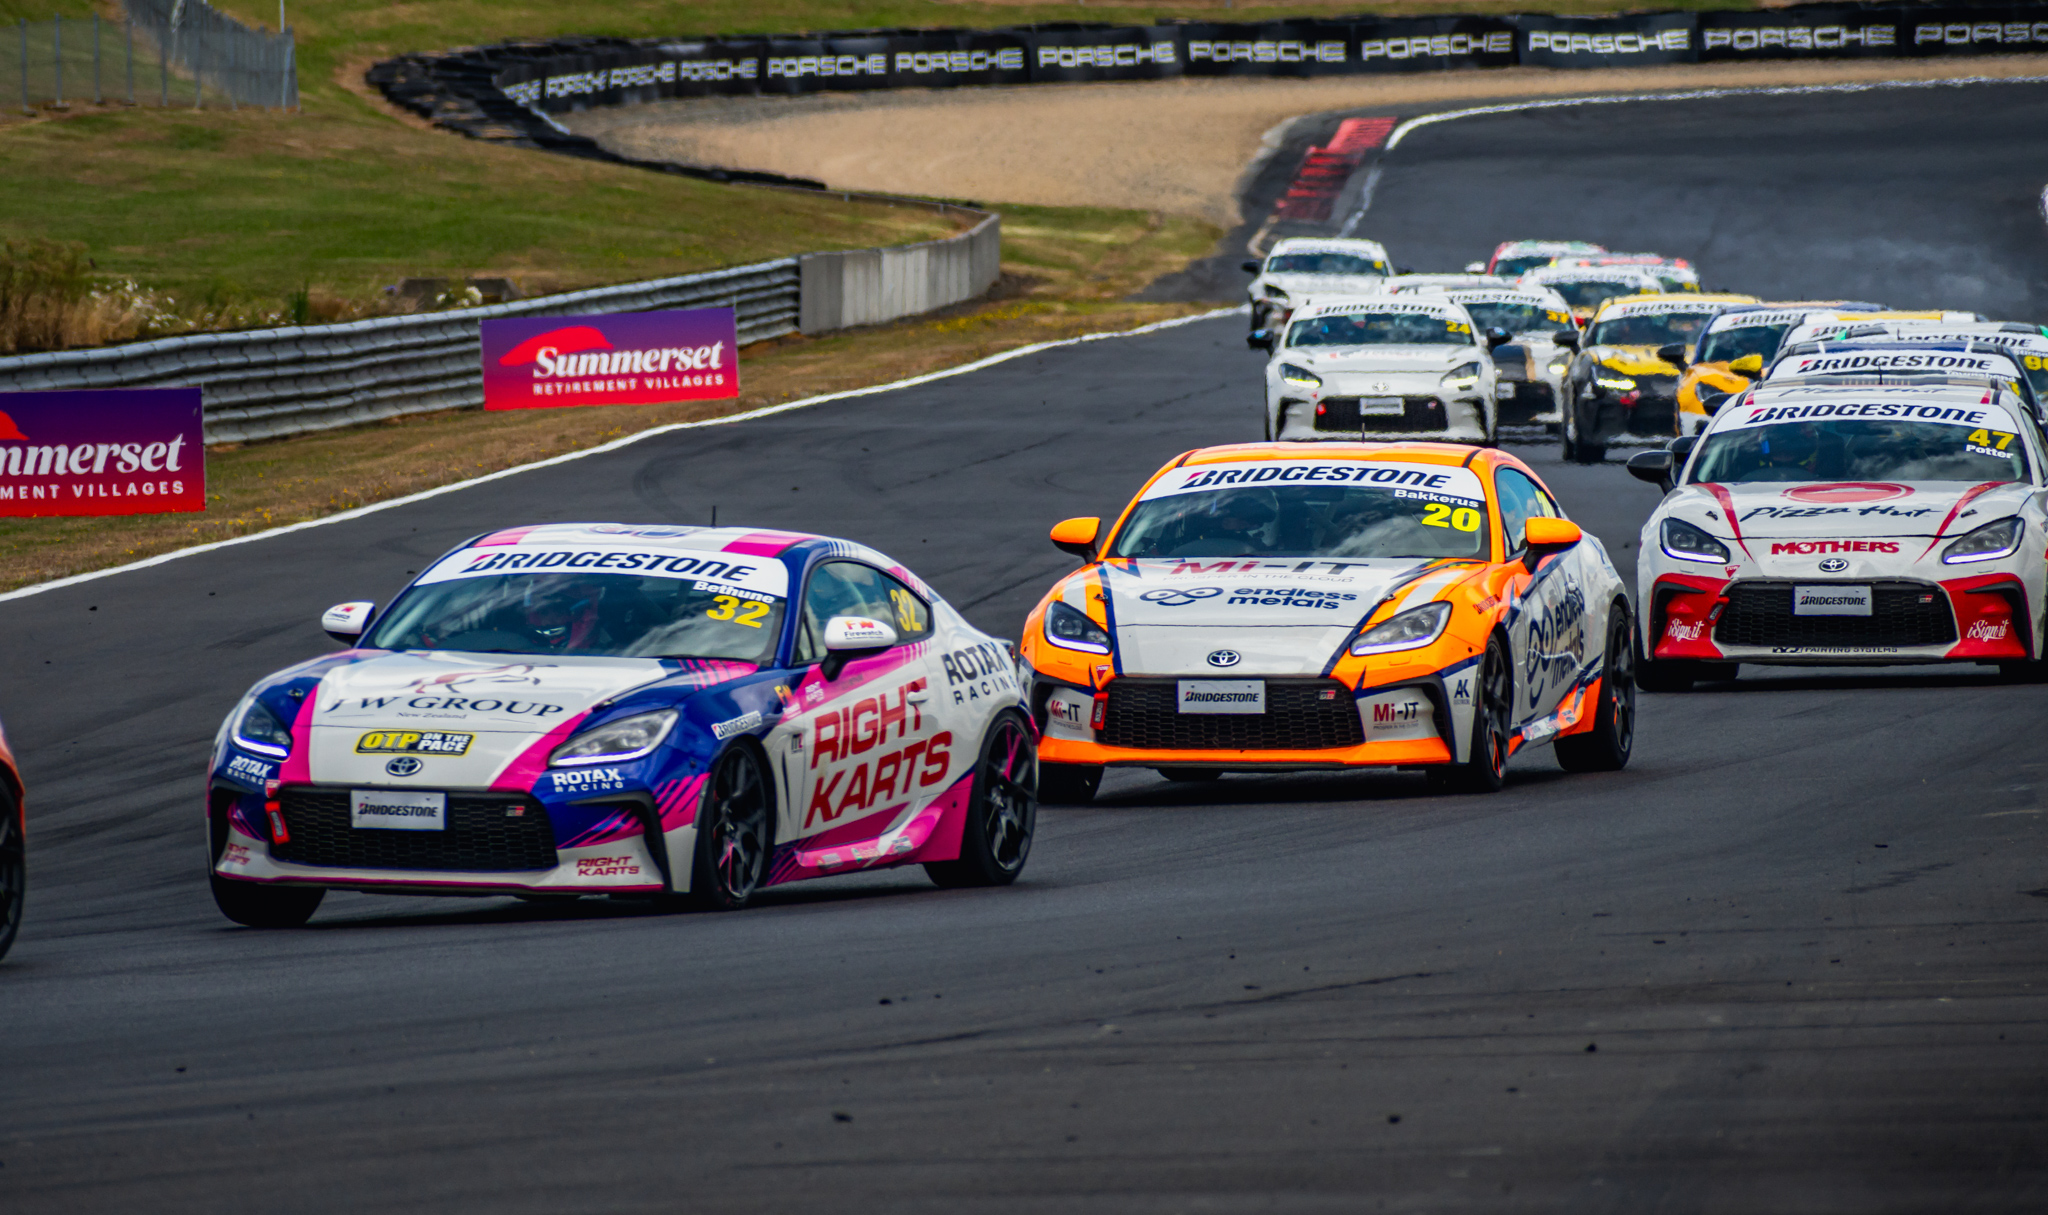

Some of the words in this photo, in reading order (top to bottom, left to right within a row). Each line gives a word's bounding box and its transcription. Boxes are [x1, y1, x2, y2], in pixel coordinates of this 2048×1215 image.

[1362, 31, 1513, 60] PORSCHE
[1529, 28, 1691, 53] PORSCHE
[1704, 25, 1896, 50] PORSCHE
[895, 48, 1024, 73] PORSCHE
[1038, 42, 1175, 68] PORSCHE
[1188, 40, 1347, 62] PORSCHE
[609, 65, 675, 88] PORSCHE
[680, 59, 757, 81] PORSCHE
[767, 54, 887, 78] PORSCHE
[1316, 303, 1448, 316] BRIDGESTONE
[533, 339, 725, 379] Summerset
[1797, 355, 1994, 374] BRIDGESTONE
[532, 378, 638, 396] RETIREMENT
[644, 373, 725, 390] VILLAGES
[1744, 403, 1988, 425] BRIDGESTONE
[1967, 428, 2015, 450] 47
[1965, 444, 2014, 459] Potter
[1179, 466, 1453, 490] BRIDGESTONE
[72, 480, 184, 499] VILLAGES
[1394, 488, 1480, 508] Bakkerus
[1421, 502, 1481, 533] 20
[1739, 505, 1852, 523] Pizza
[1857, 504, 1944, 518] Hut
[1771, 540, 1901, 555] MOTHERS
[458, 551, 758, 582] BRIDGESTONE
[1170, 561, 1370, 575] Mi-IT
[692, 579, 776, 605] Bethune
[1233, 587, 1358, 601] endless
[1800, 595, 1867, 606] BRIDGESTONE
[705, 594, 771, 629] 32
[889, 589, 923, 632] 32
[1226, 597, 1340, 610] metals
[940, 641, 1009, 687] ROTAX
[1184, 691, 1260, 703] BRIDGESTONE
[1454, 678, 1470, 699] AK
[323, 698, 345, 714] J
[360, 696, 403, 709] W
[407, 696, 565, 717] GROUP
[396, 711, 422, 719] New
[424, 711, 469, 720] Zealand
[1373, 701, 1420, 722] Mi-IT
[810, 676, 928, 770] RIGHT
[361, 732, 423, 750] OTP
[416, 739, 468, 752] PACE
[422, 732, 443, 741] ON
[445, 733, 471, 743] THE
[226, 767, 264, 786] RACING
[229, 755, 274, 778] ROTAX
[551, 768, 621, 786] ROTAX
[554, 781, 624, 793] RACING
[803, 730, 953, 830] KARTS
[357, 803, 439, 818] BRIDGESTONE
[576, 856, 633, 868] RIGHT
[578, 866, 640, 877] KARTS
